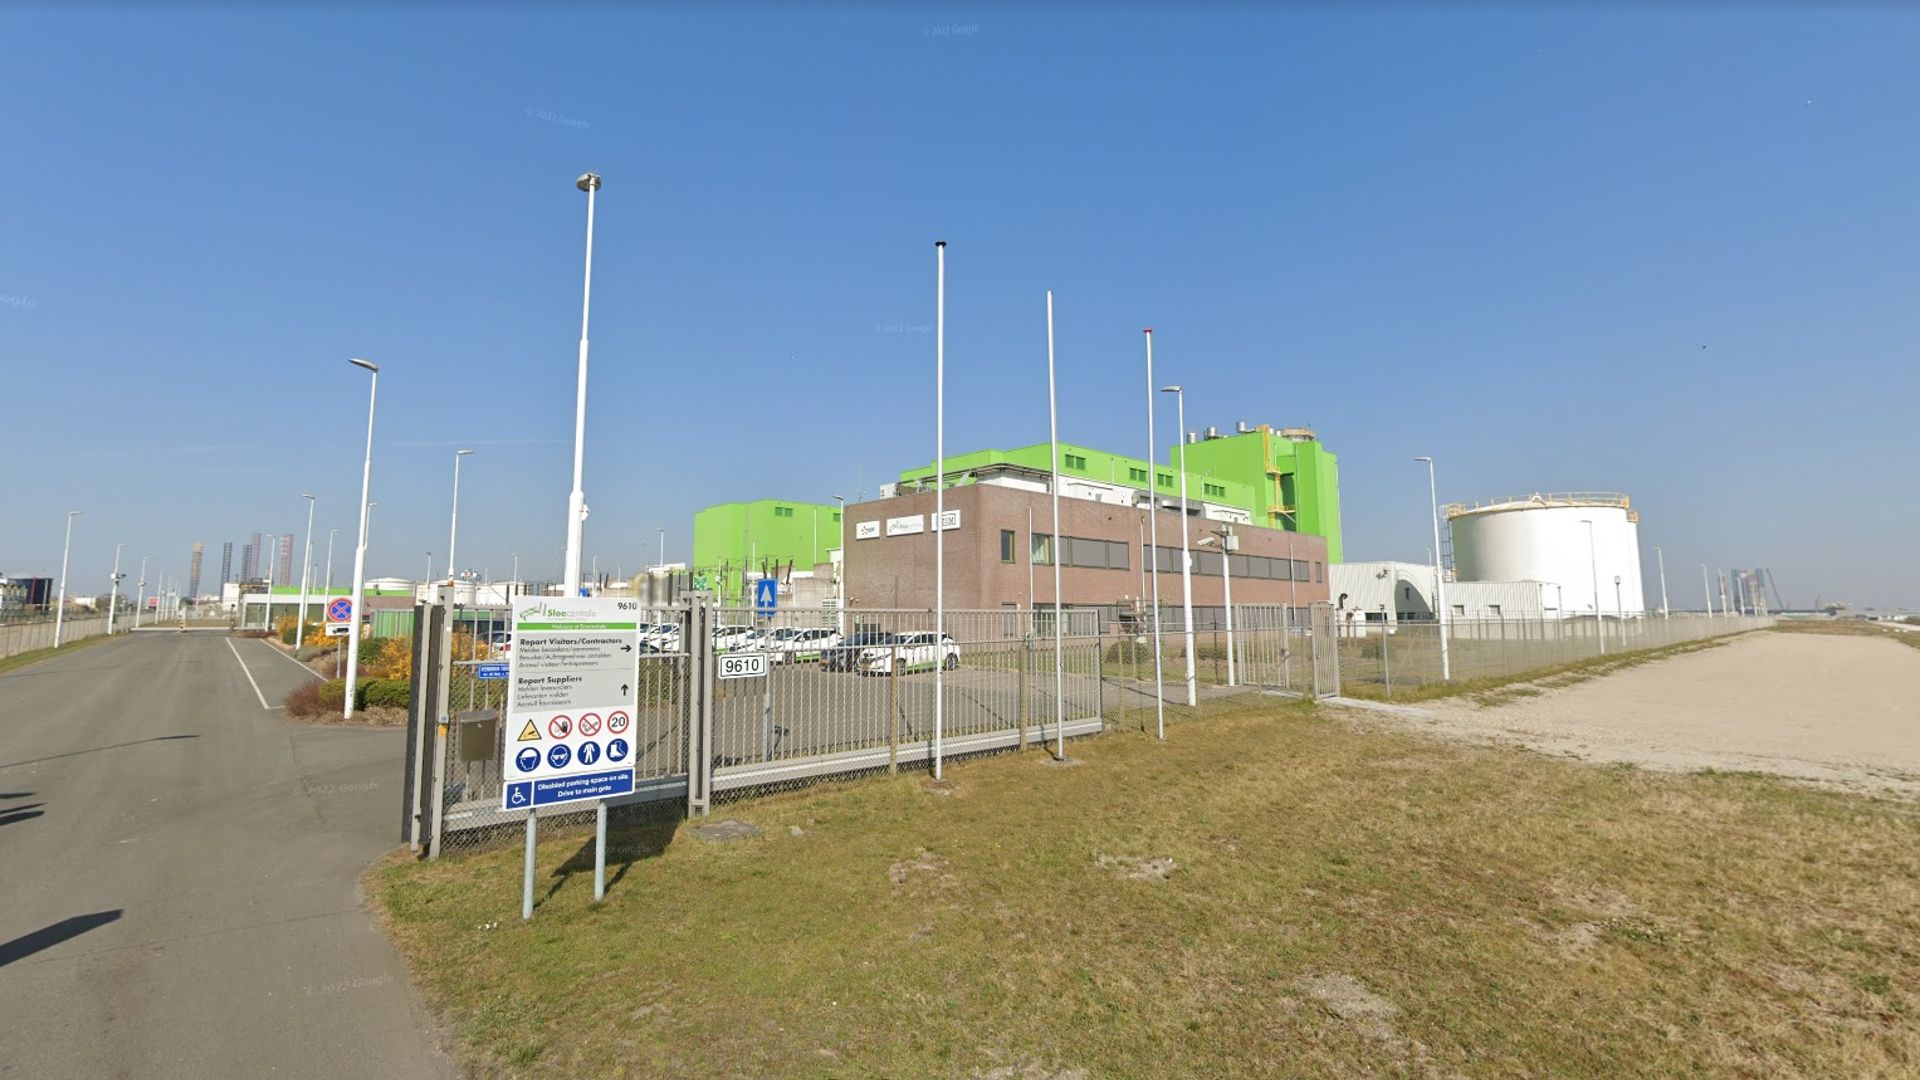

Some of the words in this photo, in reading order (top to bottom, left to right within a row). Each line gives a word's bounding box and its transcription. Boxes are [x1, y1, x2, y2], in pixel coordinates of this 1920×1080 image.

[617, 602, 637, 610] 9610
[520, 638, 547, 648] Report
[549, 637, 623, 646] Visitors/Contractors
[725, 658, 759, 673] 9610
[518, 677, 545, 687] Report
[547, 675, 583, 684] Suppliers
[611, 716, 626, 728] 20
[537, 781, 566, 791] Disabled
[566, 779, 589, 789] parking
[591, 776, 609, 785] space
[557, 789, 574, 797] Drive
[598, 785, 612, 794] gate
